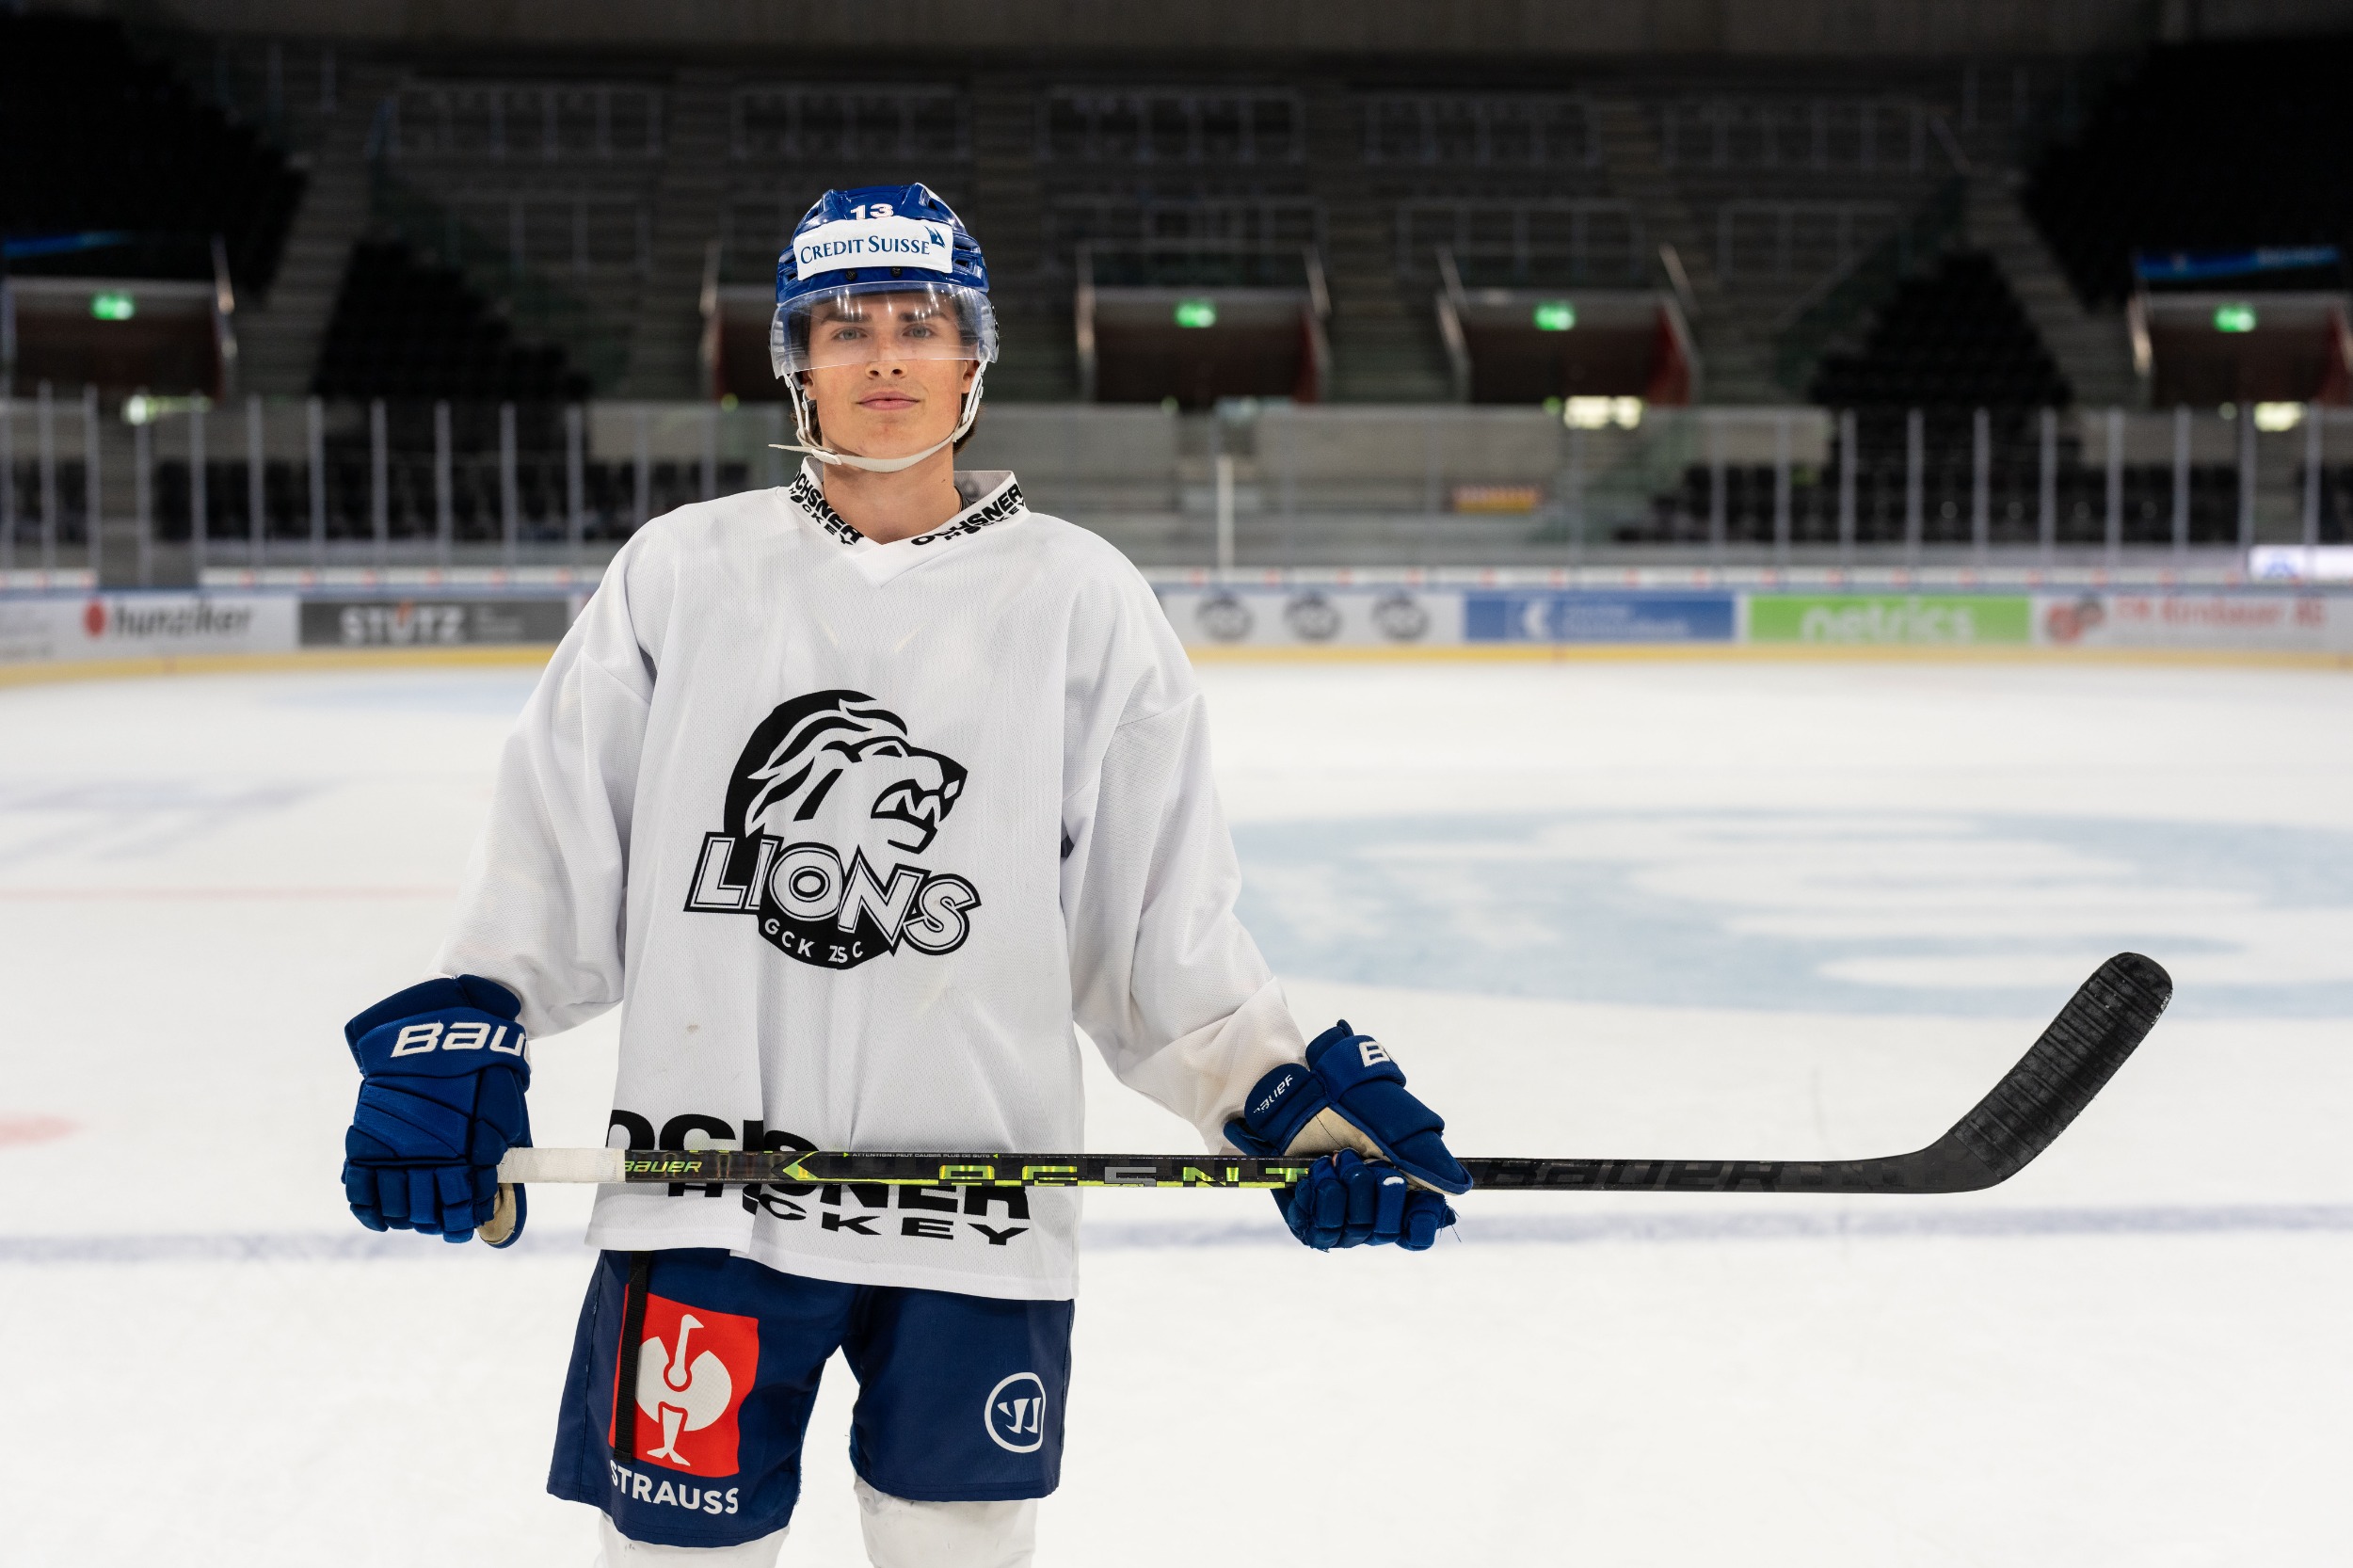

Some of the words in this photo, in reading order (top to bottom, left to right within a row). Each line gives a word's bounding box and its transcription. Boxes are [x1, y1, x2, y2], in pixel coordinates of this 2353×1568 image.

[850, 203, 894, 220] 13
[800, 239, 864, 264] CREDIT
[868, 235, 931, 256] SUISSE
[793, 467, 865, 544] CHSNER
[684, 831, 982, 956] LIONS
[764, 918, 815, 958] GCK
[390, 1020, 527, 1058] BAU
[610, 1458, 740, 1514] STRAUSS
